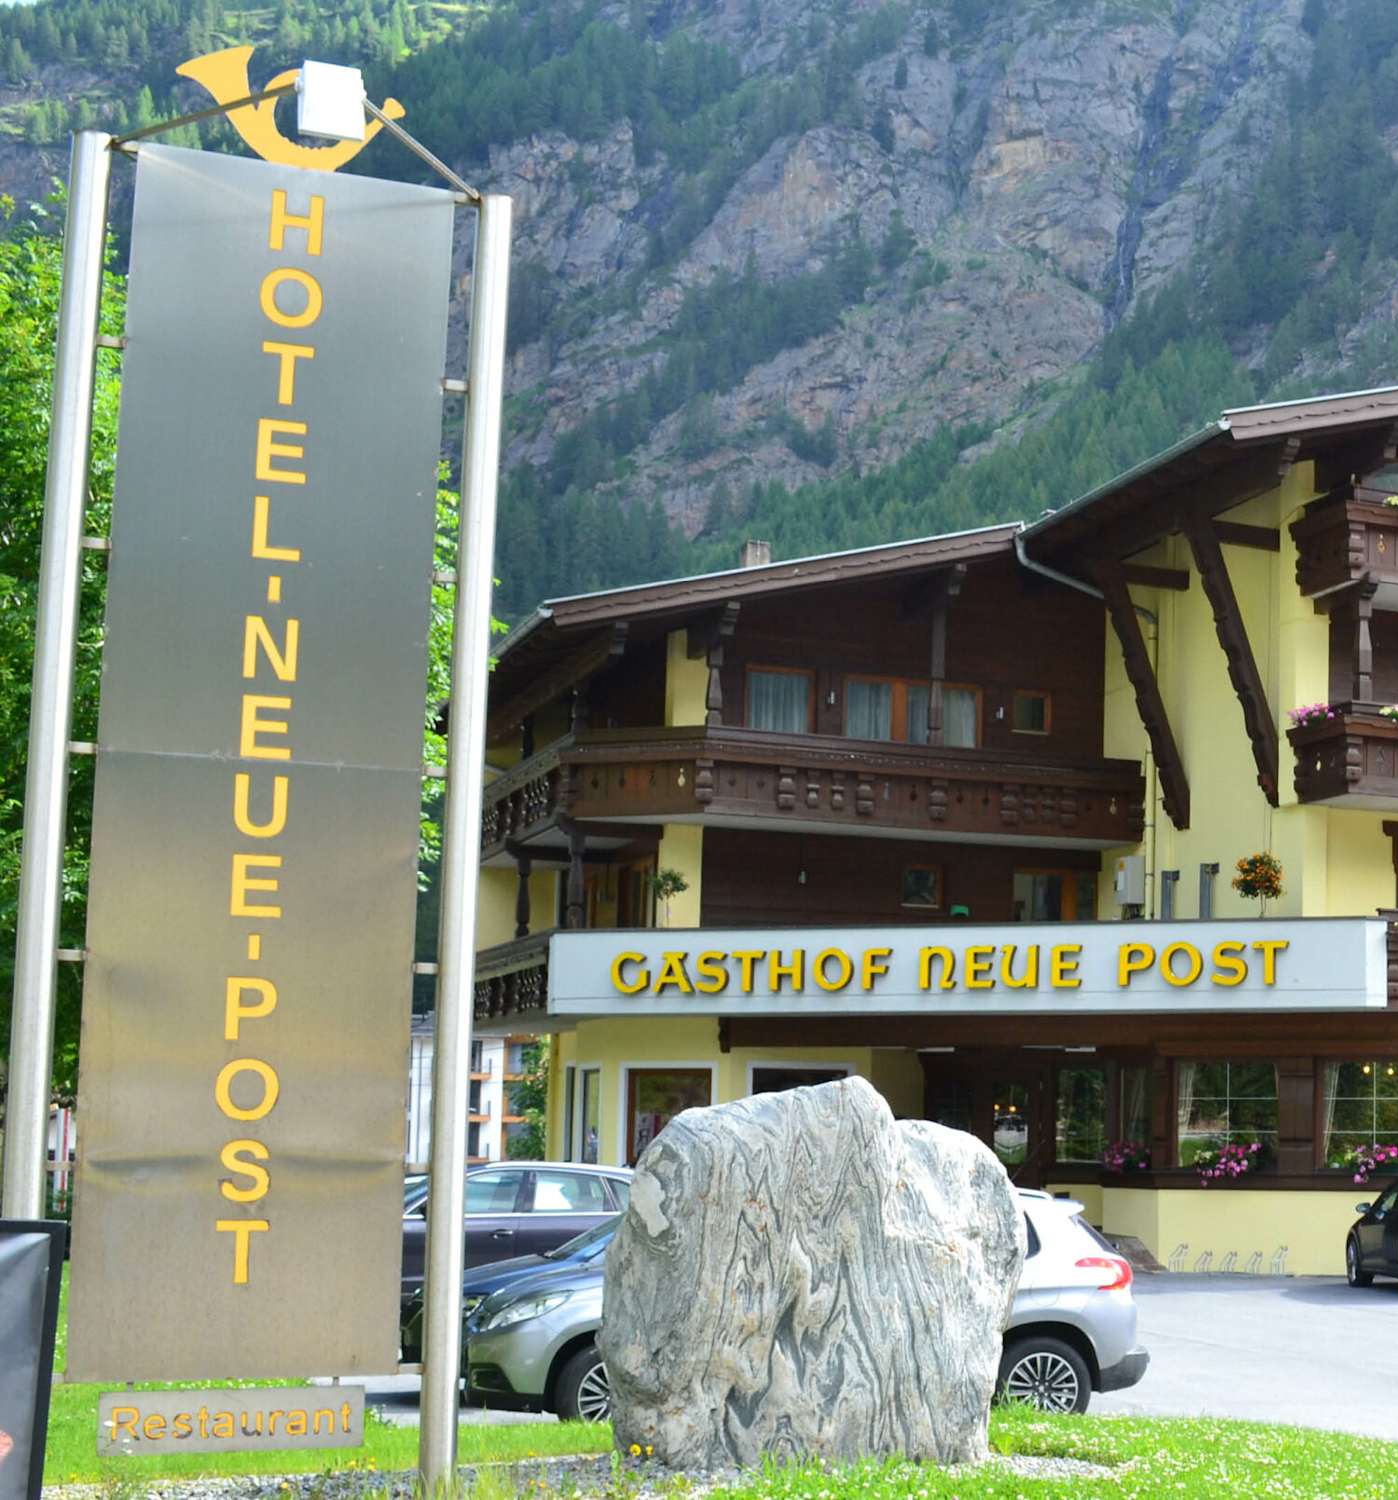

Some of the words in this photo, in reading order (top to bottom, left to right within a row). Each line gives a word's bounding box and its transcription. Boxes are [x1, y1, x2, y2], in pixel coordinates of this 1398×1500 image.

[610, 947, 892, 995] GASTHOF
[918, 943, 1083, 991] NEUE
[1117, 940, 1289, 988] POST
[109, 1401, 353, 1442] Restaurant
